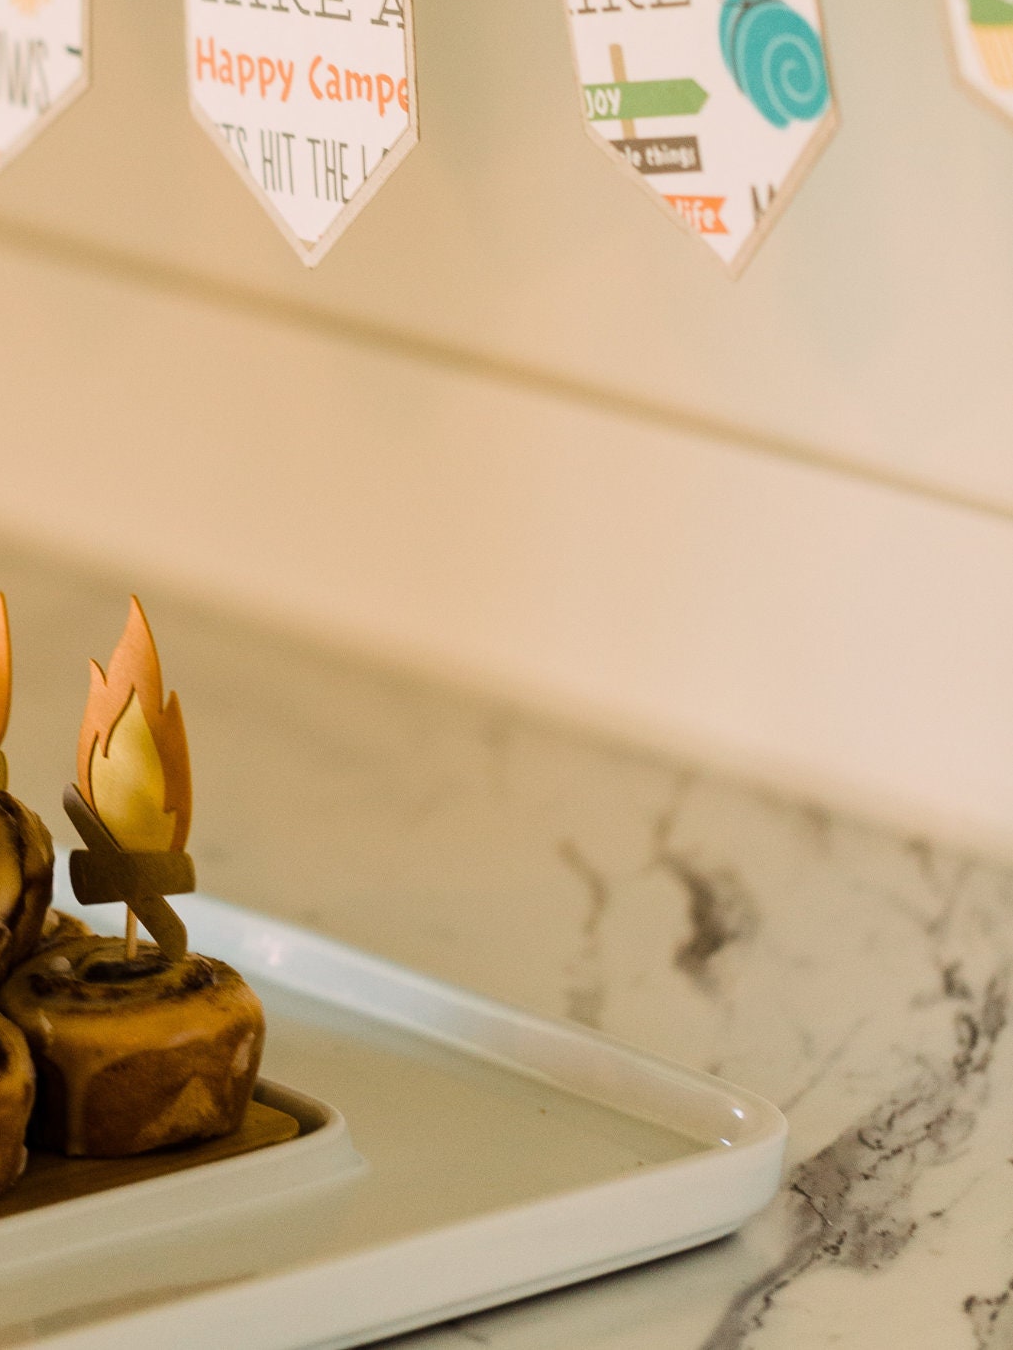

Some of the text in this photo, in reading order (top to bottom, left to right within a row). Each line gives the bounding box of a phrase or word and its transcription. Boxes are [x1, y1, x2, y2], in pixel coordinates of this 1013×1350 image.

[196, 36, 295, 102] Happy
[260, 129, 296, 195] HIT
[306, 138, 350, 204] THE
